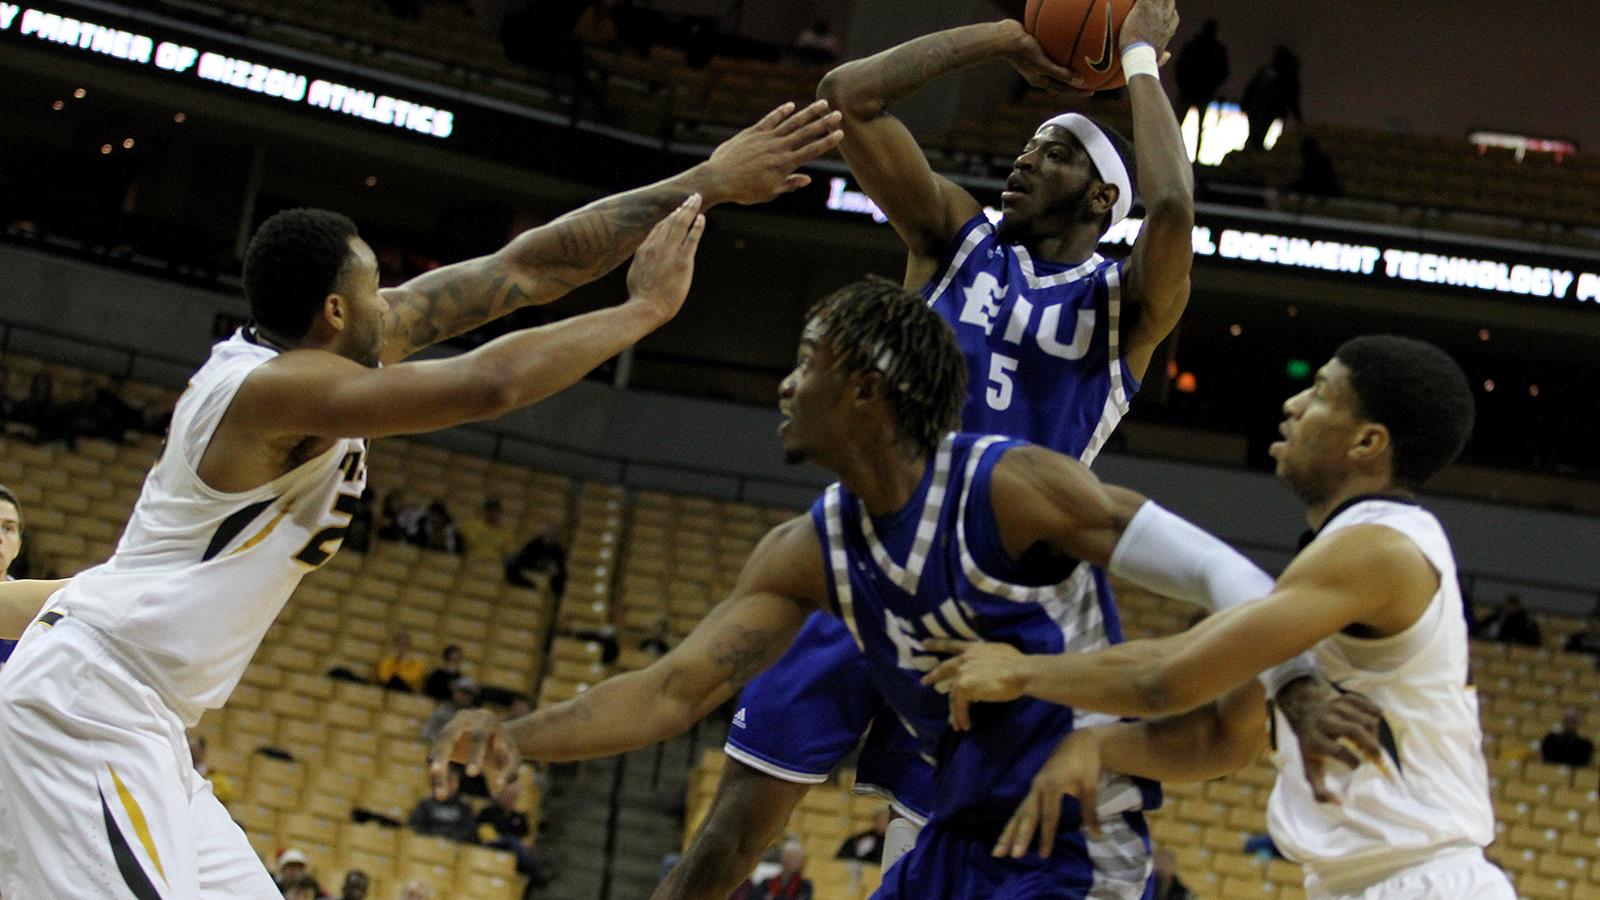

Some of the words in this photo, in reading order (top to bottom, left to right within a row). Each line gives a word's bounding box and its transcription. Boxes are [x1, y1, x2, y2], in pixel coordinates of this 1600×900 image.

[21, 9, 153, 63] PARTNER
[155, 42, 198, 72] OF
[198, 52, 307, 101] MIZZOU
[308, 80, 453, 138] ATHLETICS
[1218, 229, 1381, 275] DOCUMENT
[1384, 248, 1574, 298] TECHNOLOGY
[959, 271, 1096, 361] EIU
[985, 352, 1019, 411] 5
